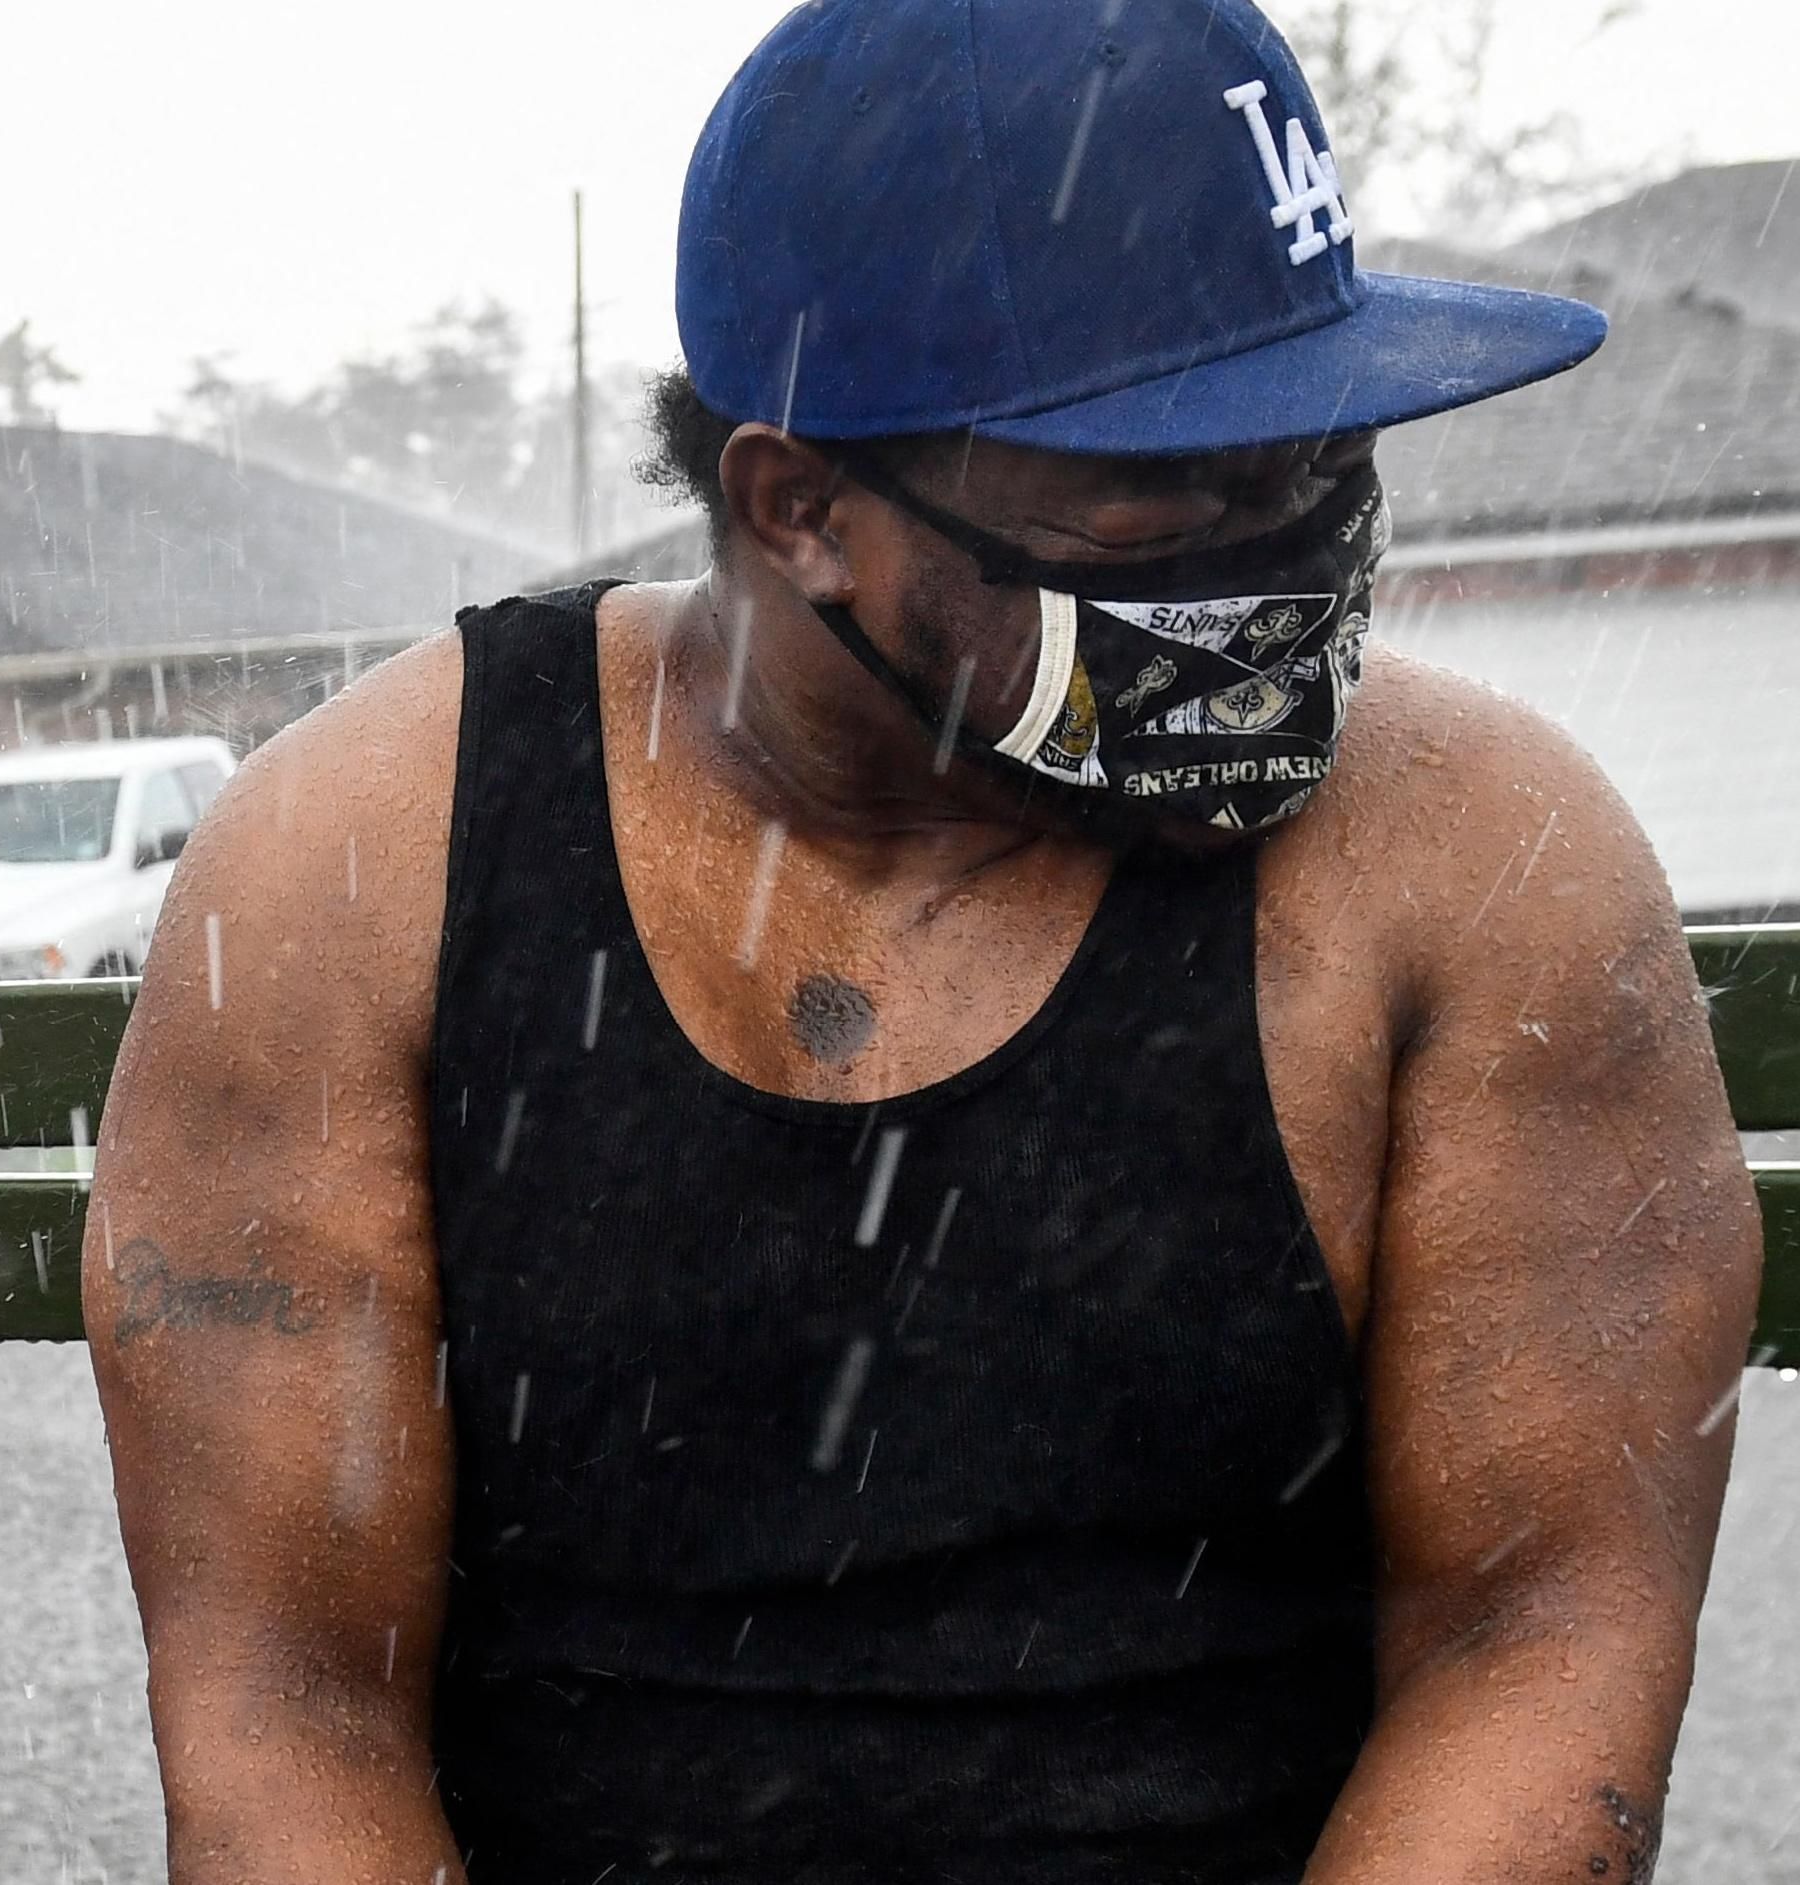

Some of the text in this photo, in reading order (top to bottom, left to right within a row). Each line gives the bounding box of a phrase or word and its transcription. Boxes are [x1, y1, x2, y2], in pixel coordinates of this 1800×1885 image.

[1223, 80, 1354, 266] LA
[1149, 606, 1238, 638] SAINTS
[1123, 756, 1332, 796] NEW ORLEANS
